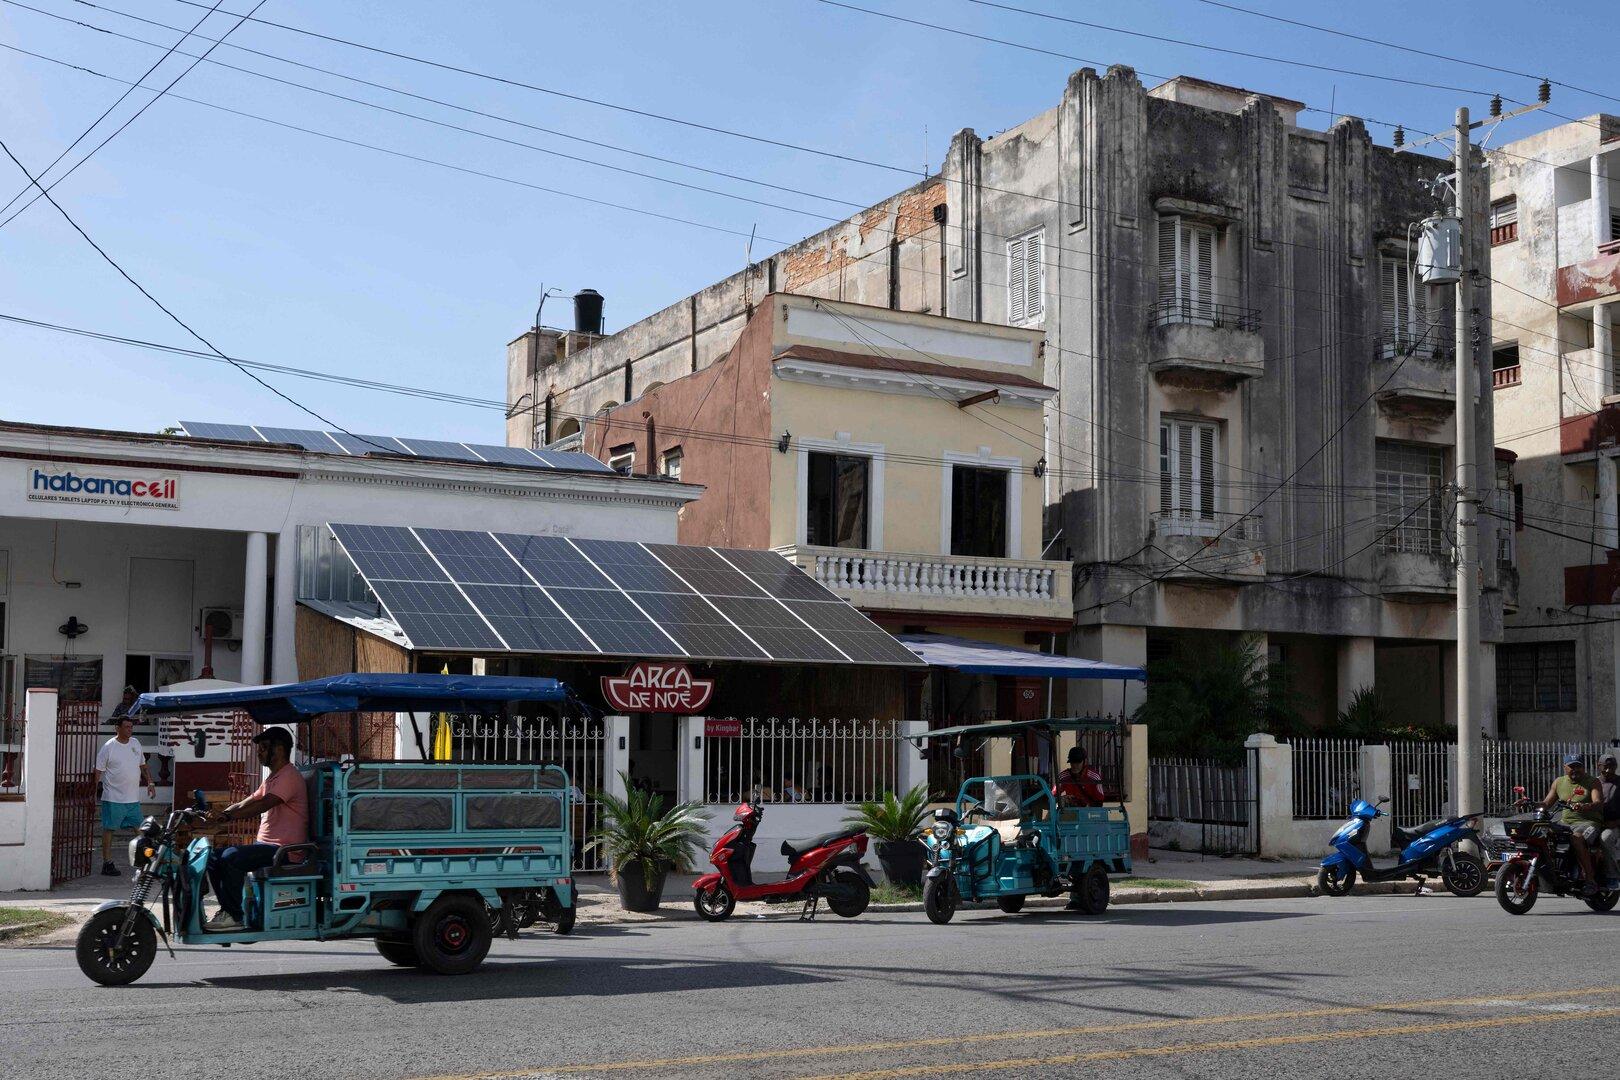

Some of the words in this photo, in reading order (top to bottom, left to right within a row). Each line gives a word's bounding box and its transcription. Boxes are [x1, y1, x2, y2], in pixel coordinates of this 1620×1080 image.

[120, 500, 155, 508] ELECTRÓNICA
[630, 666, 691, 689] ARCA
[630, 691, 651, 708] DE
[654, 690, 691, 709] NOÉ
[706, 724, 715, 733] by
